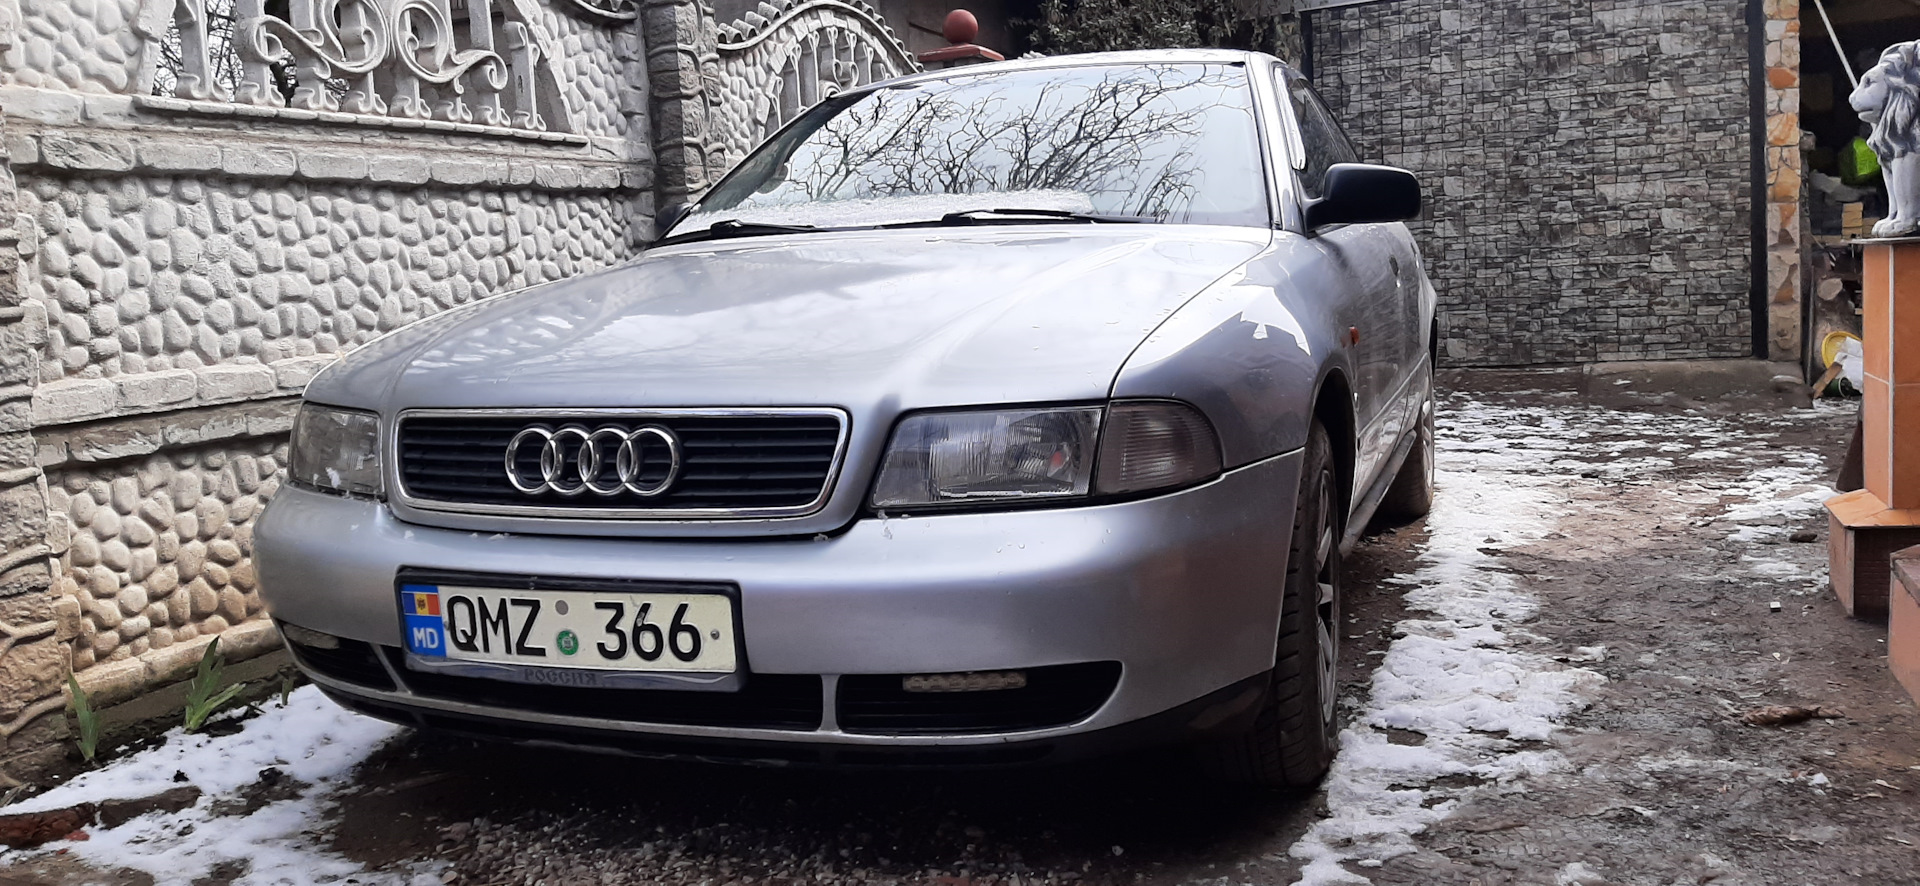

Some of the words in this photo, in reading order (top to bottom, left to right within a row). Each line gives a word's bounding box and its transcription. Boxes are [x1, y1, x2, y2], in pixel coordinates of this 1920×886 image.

[412, 626, 439, 650] MD
[447, 595, 546, 657] QMZ
[594, 602, 702, 662] 366
[524, 668, 598, 686] РОССИЯ
